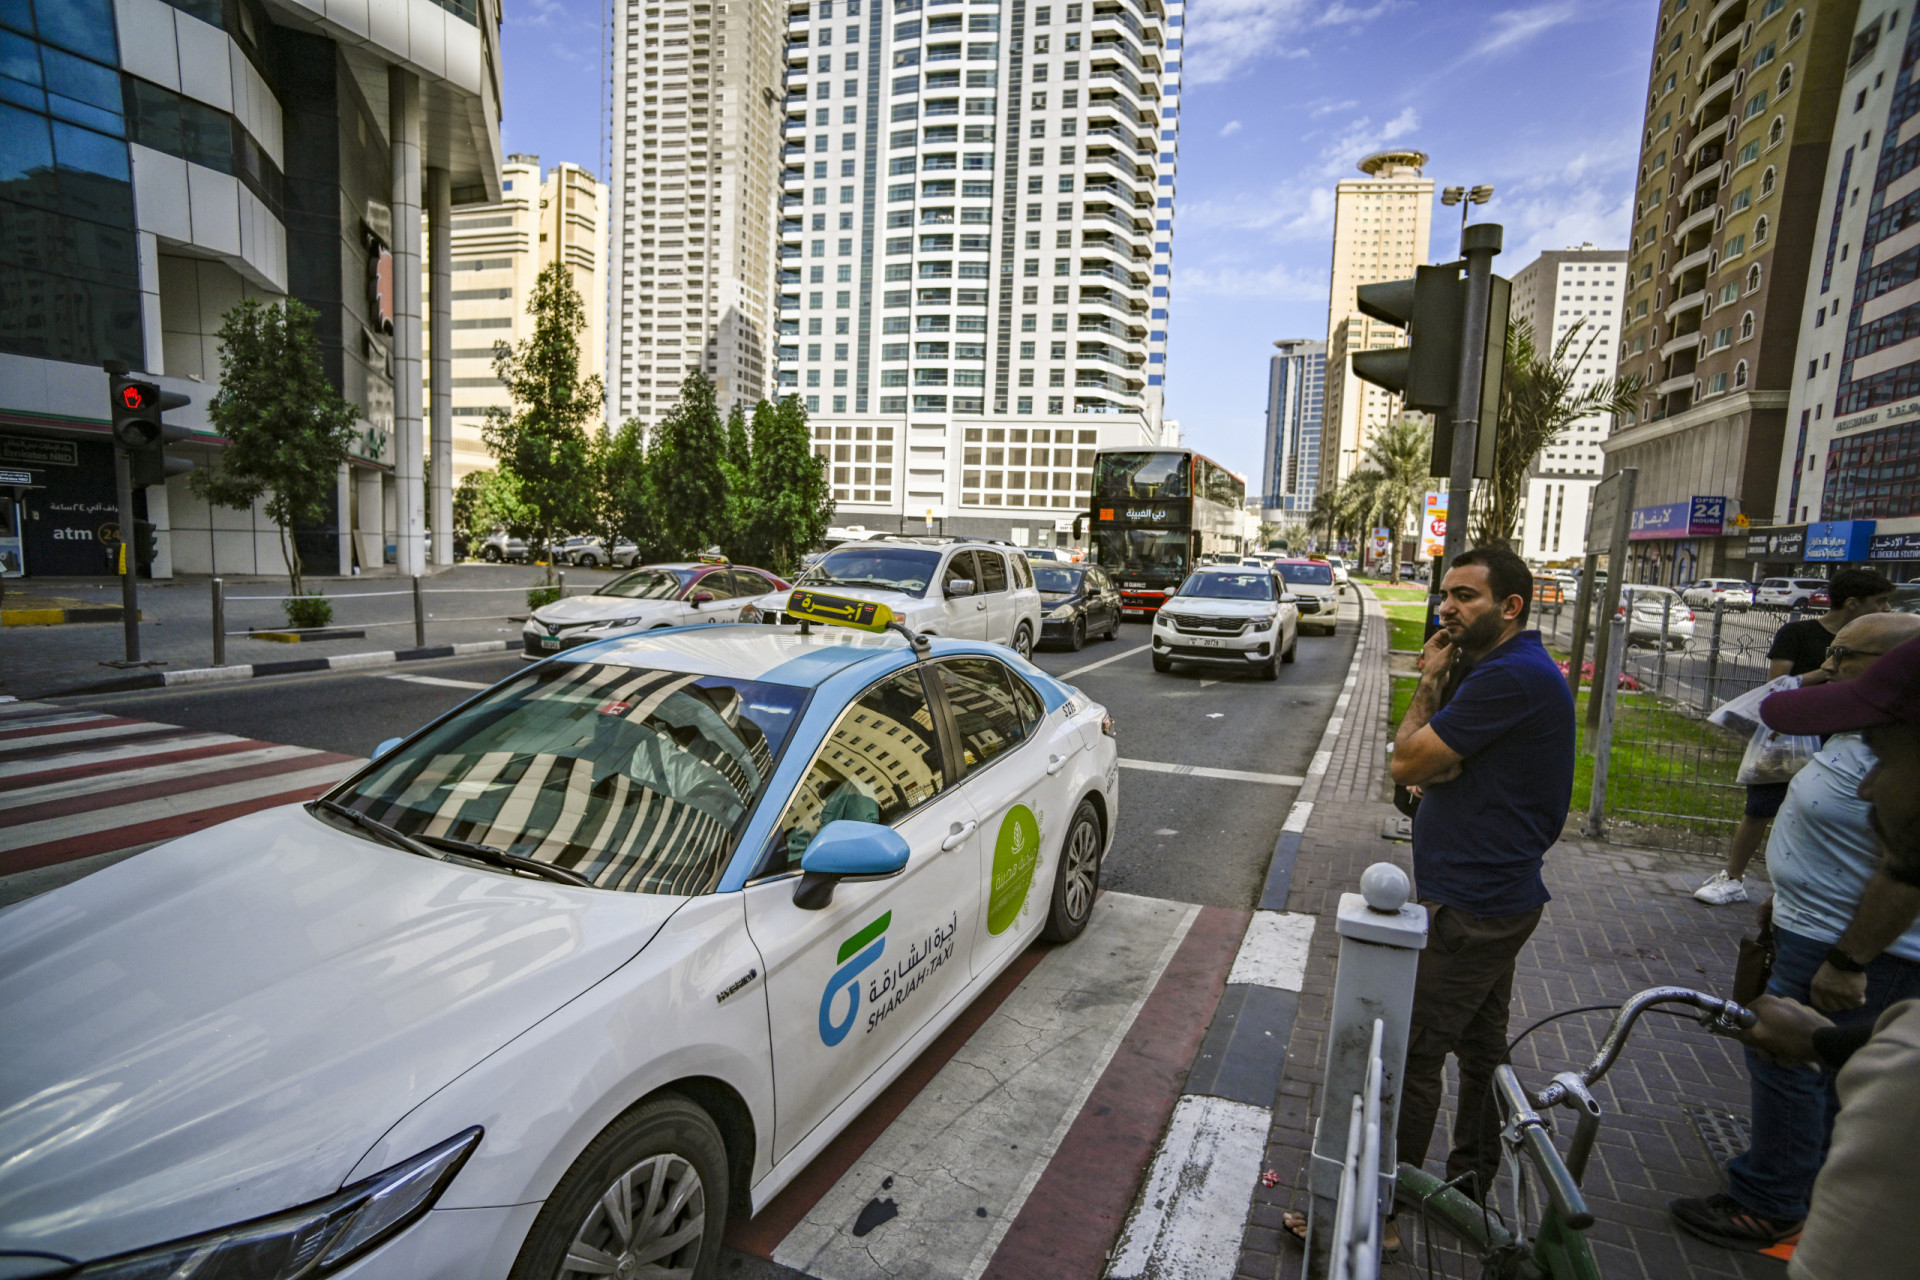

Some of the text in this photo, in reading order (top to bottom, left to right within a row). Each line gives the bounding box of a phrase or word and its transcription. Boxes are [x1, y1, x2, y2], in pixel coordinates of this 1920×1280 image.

[4, 449, 73, 462] Emirates NBD
[1152, 510, 1166, 522] دبي
[1644, 508, 1672, 528] لايف
[1694, 505, 1721, 518] 24
[1433, 521, 1446, 532] 12
[53, 527, 120, 540] atm 24
[801, 593, 865, 622] أجرة
[869, 910, 957, 1003] أجرة الشارقة
